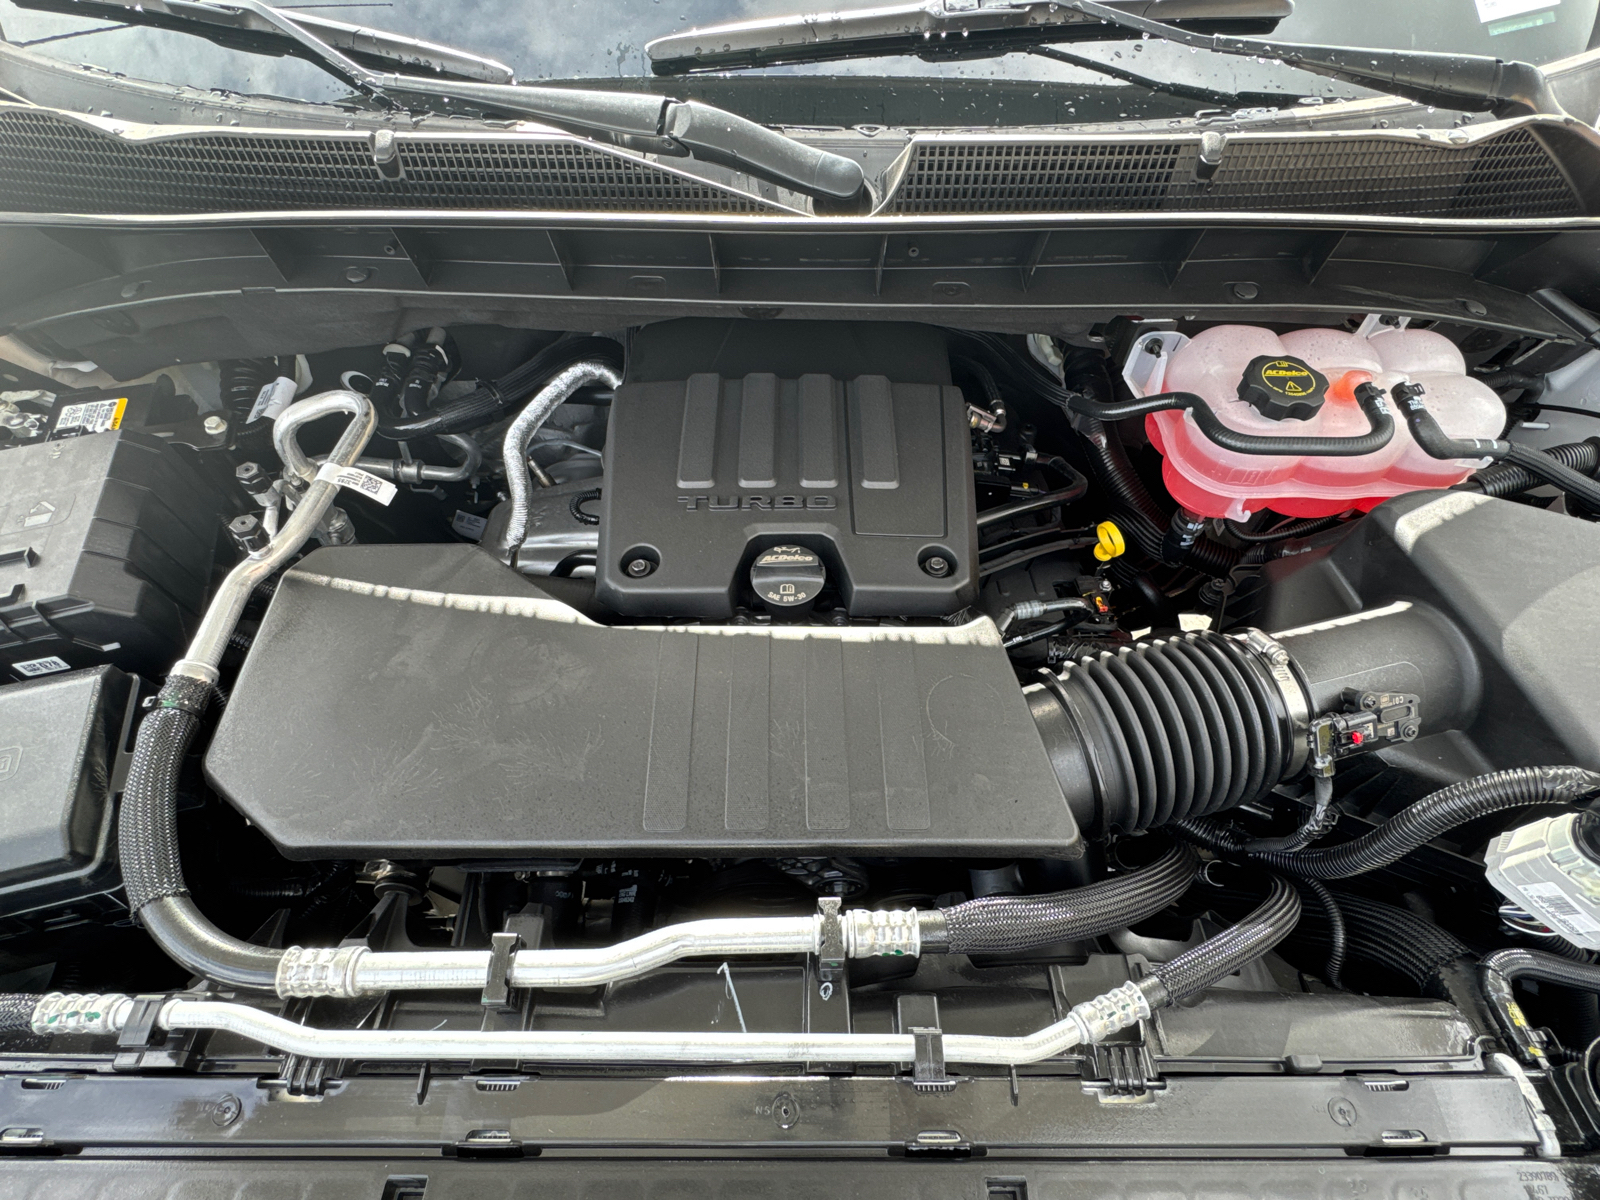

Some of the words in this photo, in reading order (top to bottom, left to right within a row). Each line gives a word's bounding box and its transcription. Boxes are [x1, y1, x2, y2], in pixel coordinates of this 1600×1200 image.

[1264, 369, 1309, 377] ACDelco
[677, 496, 838, 511] TURBO
[759, 554, 813, 563] ACDelco
[767, 591, 781, 601] SAE
[783, 592, 807, 602] 5W-30
